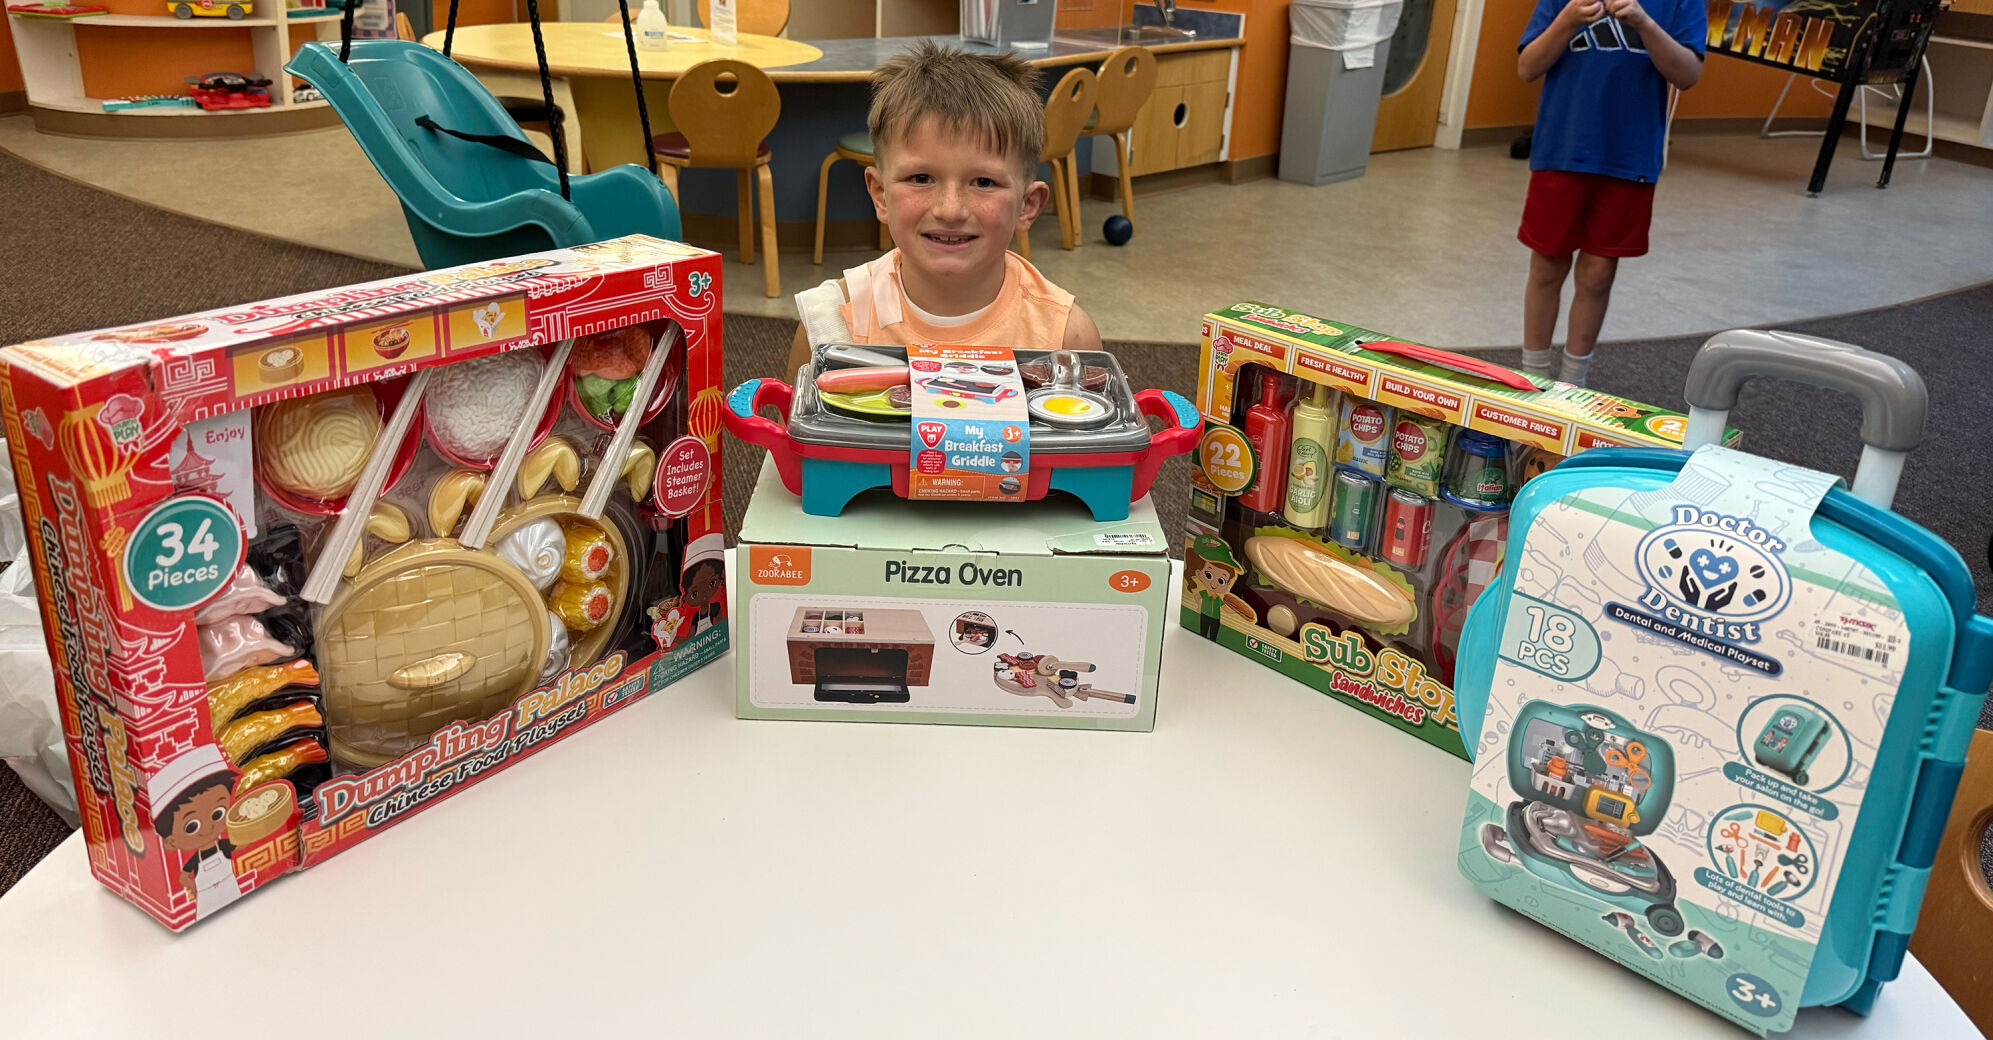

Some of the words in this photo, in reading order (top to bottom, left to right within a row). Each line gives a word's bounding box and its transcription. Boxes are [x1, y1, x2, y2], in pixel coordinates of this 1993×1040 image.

[213, 281, 430, 324] Dumpling
[426, 258, 555, 284] Palace
[688, 271, 713, 298] 3+
[1231, 303, 1286, 318] Sub
[1284, 314, 1343, 336] Stop
[1241, 314, 1310, 334] Sandwiches
[1233, 336, 1253, 348] MEAL
[1254, 342, 1273, 353] DEAL
[1301, 356, 1324, 370] FRESH
[1325, 363, 1331, 371] &
[1332, 366, 1366, 382] HEALTHY
[1385, 381, 1410, 395] BUILD
[1412, 389, 1436, 403] YOUR
[1437, 396, 1458, 409] OWN
[921, 425, 943, 433] PLAY
[965, 425, 984, 439] My
[1352, 413, 1383, 425] POTATO
[1353, 423, 1378, 434] CHIPS
[1481, 407, 1528, 428] CUSTOMER
[1529, 421, 1558, 437] FAVES
[205, 424, 246, 445] Enjoy
[944, 440, 1003, 452] Breakfast
[1006, 427, 1021, 440] 3+
[1395, 431, 1425, 445] POTATO
[679, 449, 695, 460] Set
[1209, 441, 1241, 467] 22
[1396, 442, 1420, 453] CHIPS
[666, 461, 704, 475] Includes
[951, 455, 996, 467] Griddle
[1210, 465, 1245, 480] Pieces
[666, 472, 703, 487] Steamer
[667, 483, 699, 499] Basket!
[932, 478, 964, 486] WARNING:
[1290, 486, 1316, 499] GARLIC
[1477, 483, 1504, 491] Italian
[1290, 495, 1311, 506] AIOLI
[154, 517, 221, 567] 34
[1673, 504, 1784, 555] Doctor
[147, 564, 220, 591] Pieces
[757, 569, 803, 580] ZOOKABEE
[885, 560, 951, 584] Pizza
[958, 562, 1023, 587] Oven
[1120, 575, 1140, 588] 3+
[1640, 586, 1761, 643] Dentist
[1525, 605, 1576, 655] 18
[1615, 607, 1650, 632] Dental
[1653, 619, 1676, 639] and
[1677, 629, 1725, 658] Medical
[1726, 646, 1771, 672] Playset
[40, 516, 71, 628] Chinese
[64, 627, 88, 697] Food
[79, 695, 109, 795] Playset
[674, 629, 722, 662] WARNING:
[1260, 647, 1278, 659] TESTED
[1261, 642, 1278, 653] SAFETY
[1304, 625, 1374, 674] Sub
[48, 474, 115, 708] Dumpling
[100, 706, 145, 856] Palace
[678, 651, 699, 668] HAZARD
[1517, 646, 1569, 676] PCS
[1330, 671, 1425, 725] Sandwiches
[319, 712, 510, 826] Dumpling
[517, 654, 624, 728] Palace
[368, 775, 453, 827] Chinese
[457, 743, 508, 781] Food
[513, 700, 588, 753] Playset
[1735, 775, 1755, 786] your
[1755, 783, 1779, 797] salon
[1780, 793, 1792, 803] on
[1793, 798, 1808, 810] the
[1808, 806, 1825, 817] go!
[1745, 768, 1767, 783] Pack
[1767, 779, 1779, 788] up
[1780, 783, 1798, 796] and
[1799, 791, 1818, 805] take
[1705, 870, 1723, 884] Lots
[1724, 880, 1735, 888] of
[1735, 885, 1762, 901] dental
[1763, 897, 1785, 912] tools
[1785, 907, 1796, 917] to
[1708, 881, 1727, 894] play
[1727, 890, 1744, 901] and
[1744, 896, 1767, 912] learn
[1767, 907, 1788, 922] with.
[1731, 977, 1777, 1009] 3+
